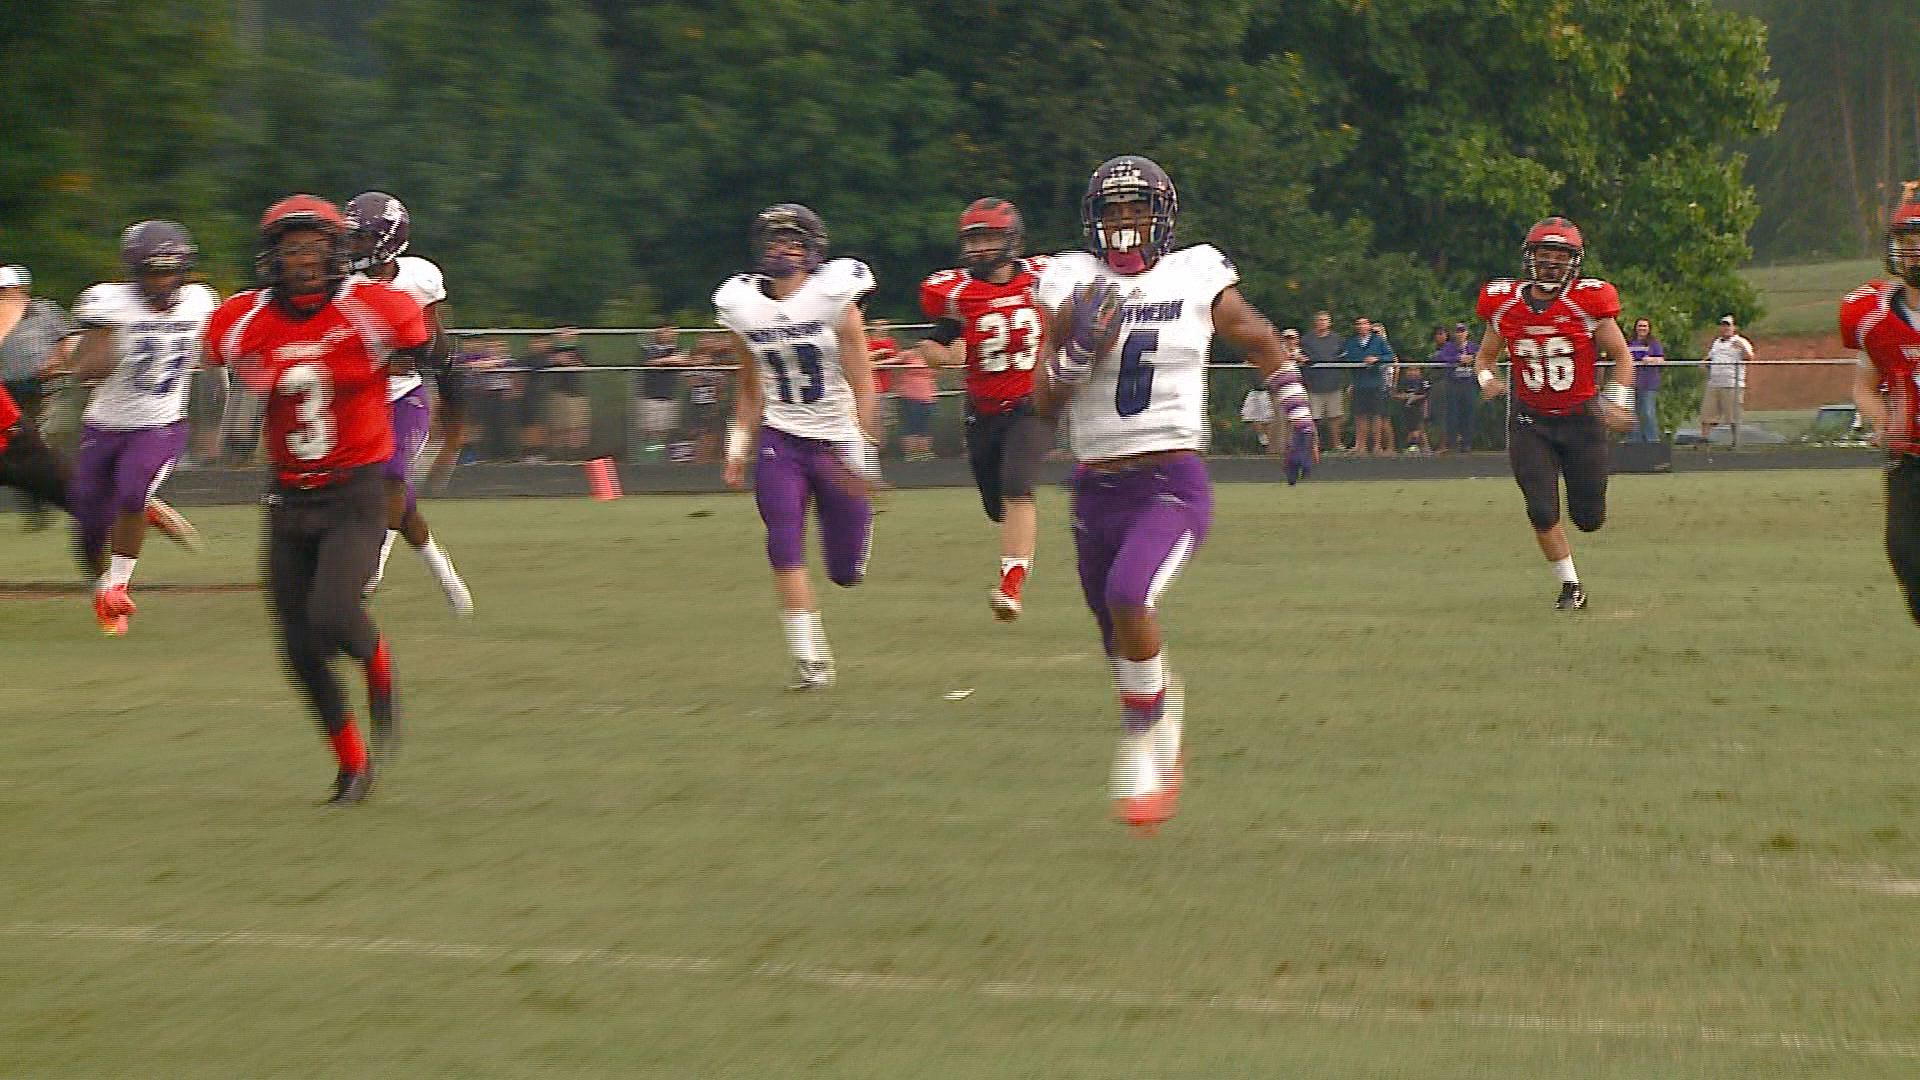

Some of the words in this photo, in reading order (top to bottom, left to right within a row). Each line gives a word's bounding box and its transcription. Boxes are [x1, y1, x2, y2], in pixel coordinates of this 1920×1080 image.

[974, 308, 1042, 372] 23
[1120, 299, 1185, 324] THERN
[762, 343, 825, 405] 13
[1115, 329, 1160, 418] 6
[1513, 336, 1575, 392] 36
[276, 359, 339, 461] 3
